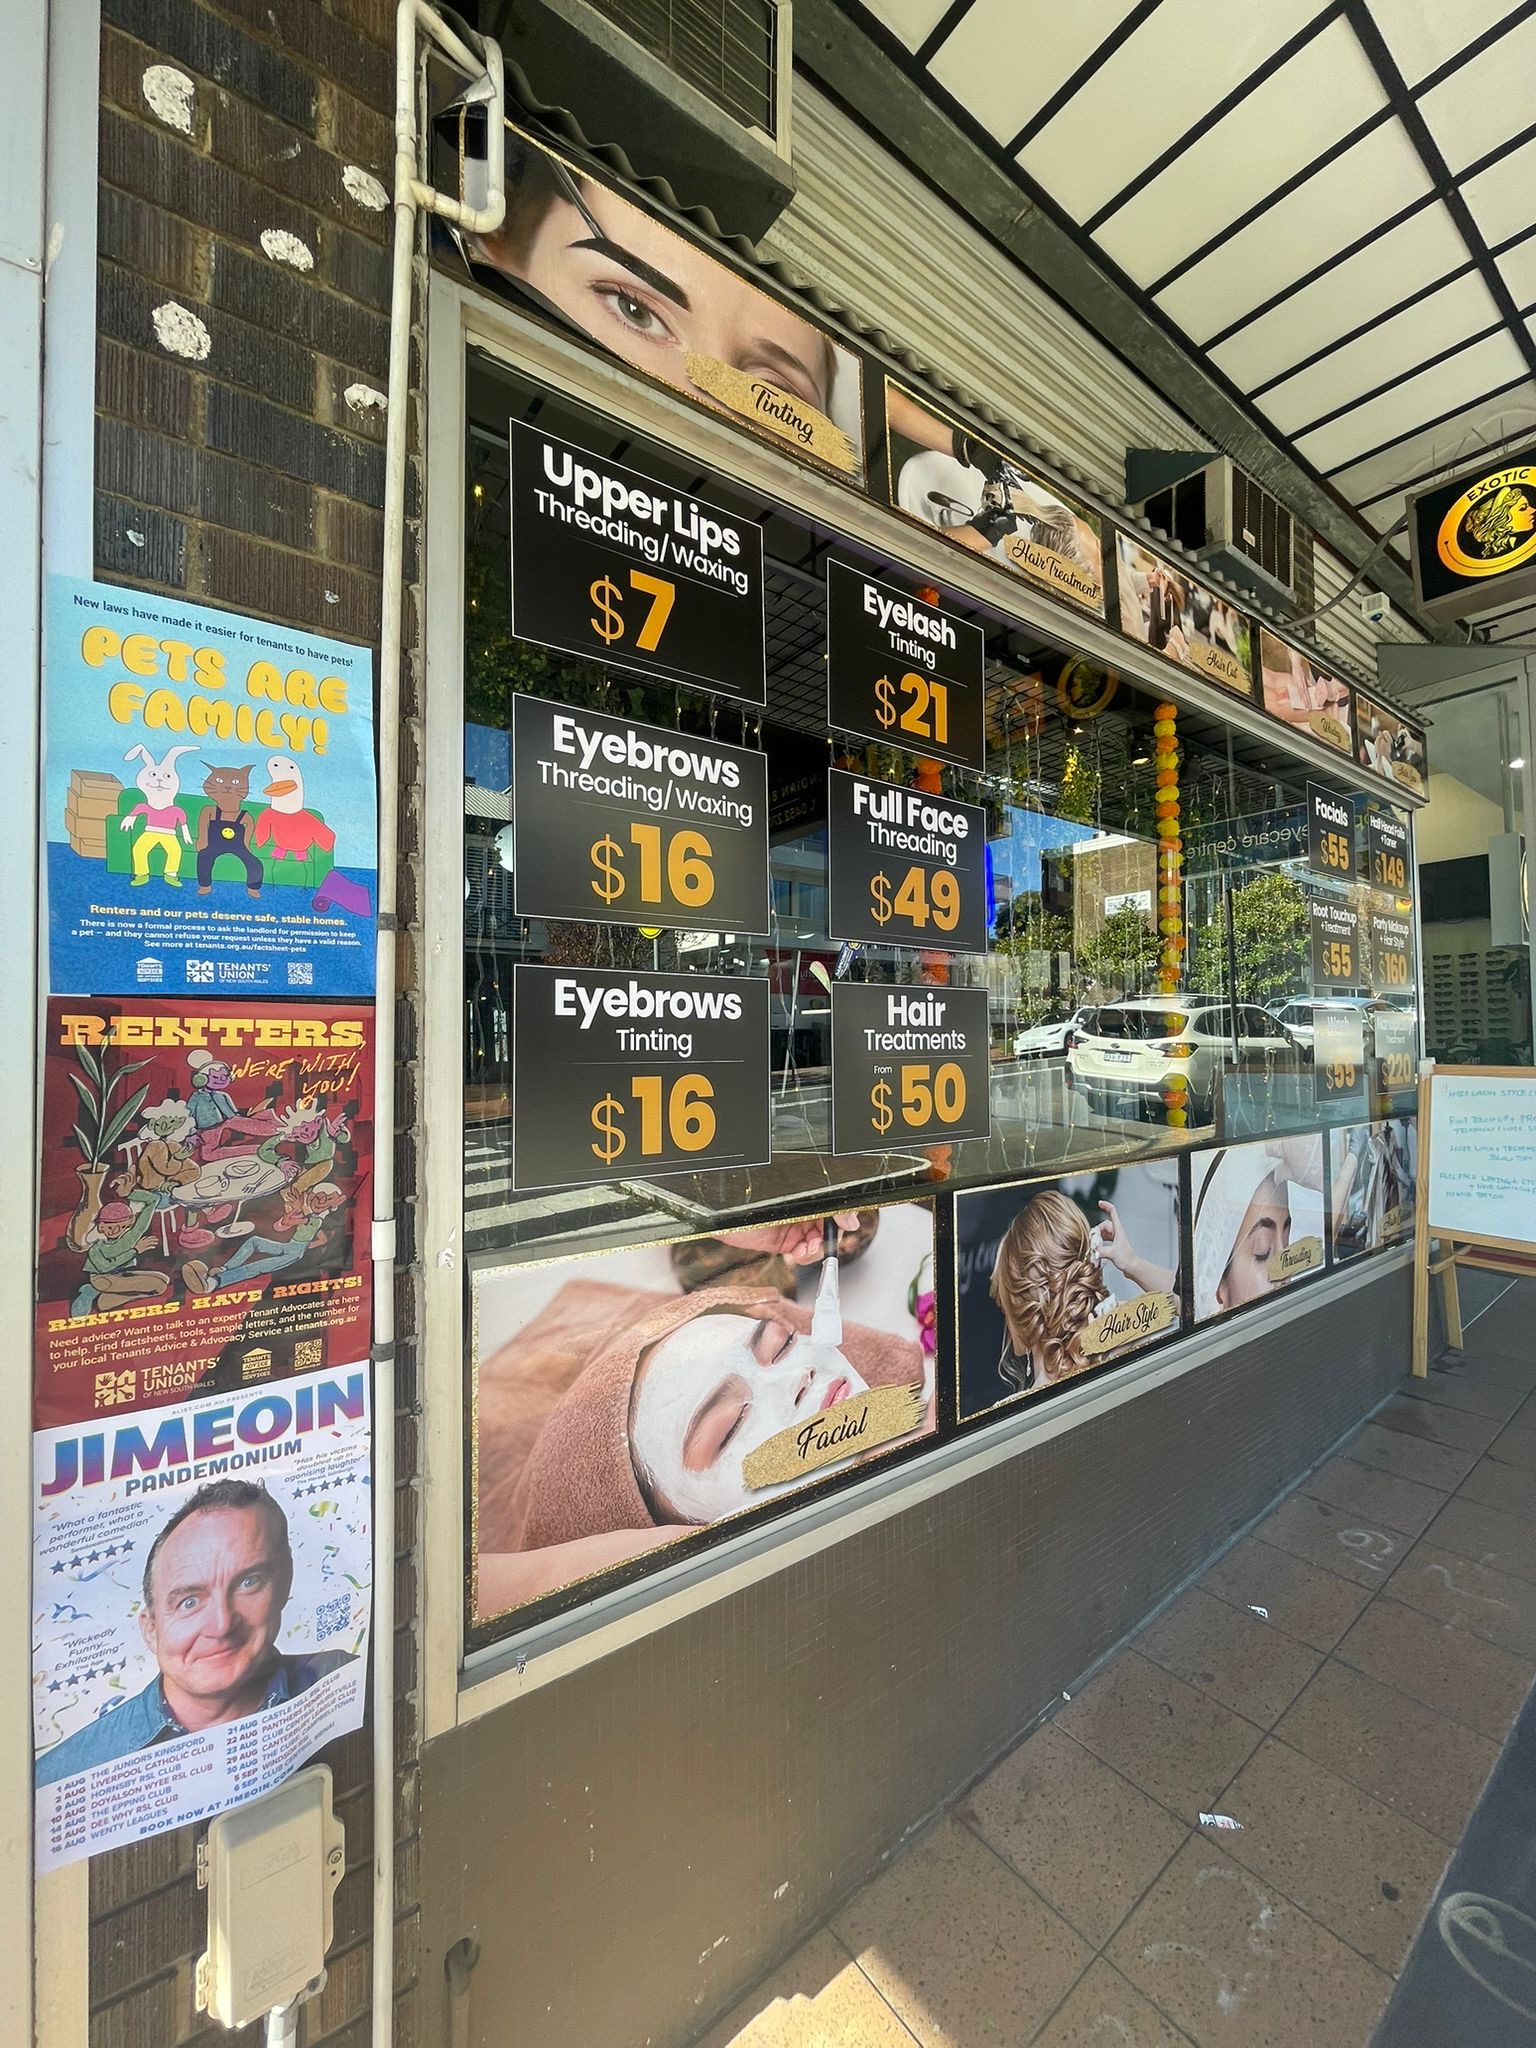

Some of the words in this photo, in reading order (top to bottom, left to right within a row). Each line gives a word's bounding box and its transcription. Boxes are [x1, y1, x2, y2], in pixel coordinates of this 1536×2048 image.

[750, 383, 815, 446] Tinting
[542, 444, 667, 527] Upper
[673, 504, 741, 557] Lips
[1466, 468, 1531, 501] EXOTIC
[533, 489, 749, 596] Threading/Waxing
[1011, 538, 1046, 572] Hair
[1045, 558, 1100, 602] Treatment
[588, 568, 676, 653] $7
[863, 583, 957, 650] Eyelash
[73, 595, 100, 609] New
[103, 601, 129, 616] laws
[132, 607, 159, 622] have
[162, 615, 192, 629] made
[195, 620, 203, 631] it
[205, 624, 237, 638] easier
[240, 631, 254, 642] for
[256, 636, 293, 653] tenants
[296, 646, 305, 656] to
[308, 648, 329, 662] have
[331, 656, 353, 668] pets!
[887, 629, 937, 670] Tinting
[81, 625, 227, 690] PETS
[246, 659, 349, 714] ARE
[1206, 649, 1226, 672] Hair
[1226, 662, 1238, 679] Cut
[108, 680, 329, 756] FAMILY!
[873, 672, 950, 745] $21
[552, 715, 741, 790] Eyebrows
[536, 759, 753, 828] Threading/Waxing
[852, 783, 903, 824] Full
[907, 795, 969, 839] Face
[1315, 796, 1349, 828] Facials
[866, 820, 958, 867] Threading
[1320, 831, 1350, 871] $55
[588, 822, 717, 908] $16
[1375, 852, 1405, 889] $149
[90, 904, 137, 916] Renters
[139, 907, 161, 917] and
[185, 911, 209, 920] pets
[211, 911, 252, 922] deserve
[255, 914, 279, 924] safe,
[281, 915, 312, 925] stable
[313, 917, 348, 926] homes.
[869, 866, 961, 932] $49
[1313, 902, 1329, 918] Root
[1329, 905, 1357, 928] Touchup
[144, 940, 161, 948] See
[1373, 916, 1388, 932] Party
[1388, 920, 1410, 938] Makeup
[217, 962, 271, 972] TENANTS'
[219, 971, 255, 979] UNION
[1323, 942, 1352, 979] $55
[1379, 951, 1408, 985] $160
[554, 978, 743, 1029] Eyebrows
[887, 992, 947, 1027] Hair
[615, 1028, 693, 1058] Tinting
[864, 1028, 967, 1053] Treatments
[231, 1057, 295, 1080] WE'RE
[300, 1051, 356, 1076] WITH
[302, 1062, 361, 1109] YOU!
[873, 1065, 893, 1074] From
[1326, 1057, 1356, 1092] $55
[1382, 1053, 1411, 1086] $220
[590, 1073, 718, 1166] $16
[870, 1062, 968, 1136] $50
[1280, 1244, 1313, 1271] Threading
[48, 1301, 181, 1333] RENTERS
[192, 1290, 263, 1310] HAVE
[272, 1275, 362, 1299] RIGHTS!
[50, 1336, 79, 1348] Need
[82, 1330, 121, 1343] advice?
[124, 1325, 150, 1336] Want
[153, 1324, 163, 1332] to
[166, 1319, 184, 1330] talk
[186, 1319, 196, 1327] to
[198, 1317, 210, 1325] an
[212, 1311, 247, 1325] expert?
[249, 1306, 279, 1318] Tenant
[281, 1301, 325, 1315] Advocates
[327, 1298, 340, 1306] are
[341, 1295, 360, 1304] here
[1099, 1312, 1131, 1343] Hair
[1131, 1301, 1159, 1333] Style
[50, 1351, 61, 1360] to
[64, 1347, 90, 1360] help.
[94, 1341, 118, 1353] Find
[120, 1332, 177, 1348] factsheets,
[180, 1328, 205, 1339] tools,
[209, 1322, 243, 1336] sample
[245, 1317, 277, 1329] letters,
[279, 1314, 296, 1324] and
[298, 1311, 311, 1321] the
[314, 1306, 346, 1319] number
[348, 1304, 360, 1313] for
[53, 1360, 79, 1373] your
[81, 1354, 107, 1366] local
[110, 1347, 152, 1360] Tenants
[153, 1339, 188, 1353] Advice
[189, 1339, 198, 1347] &
[200, 1332, 246, 1346] Advocacy
[248, 1327, 282, 1339] Service
[284, 1323, 293, 1332] at
[295, 1315, 357, 1331] tenants.org.au
[141, 1357, 221, 1380] TENANTS'
[144, 1372, 196, 1391] UNION
[226, 1390, 263, 1402] PRESENTS
[40, 1373, 366, 1498] JIMEOIN
[796, 1406, 868, 1459] Facial
[125, 1438, 303, 1497] PANDEMONIUM
[284, 1466, 326, 1484] agonising
[49, 1522, 106, 1546] performer,
[109, 1512, 134, 1525] what
[98, 1501, 143, 1520] fantastic
[39, 1534, 95, 1556] wonderful
[55, 1796, 62, 1804] 2
[64, 1787, 87, 1801] AUG
[90, 1768, 142, 1790] LIVERPOOL
[145, 1752, 189, 1771] CATHOLIC
[191, 1743, 214, 1757] CLUB
[64, 1777, 87, 1791] AUG
[91, 1768, 110, 1780] THE
[112, 1754, 153, 1774] JUNIORS
[154, 1736, 206, 1758] KINGSFORD
[140, 1818, 173, 1835] BOOK
[177, 1808, 204, 1822] NOW
[207, 1801, 221, 1812] AT
